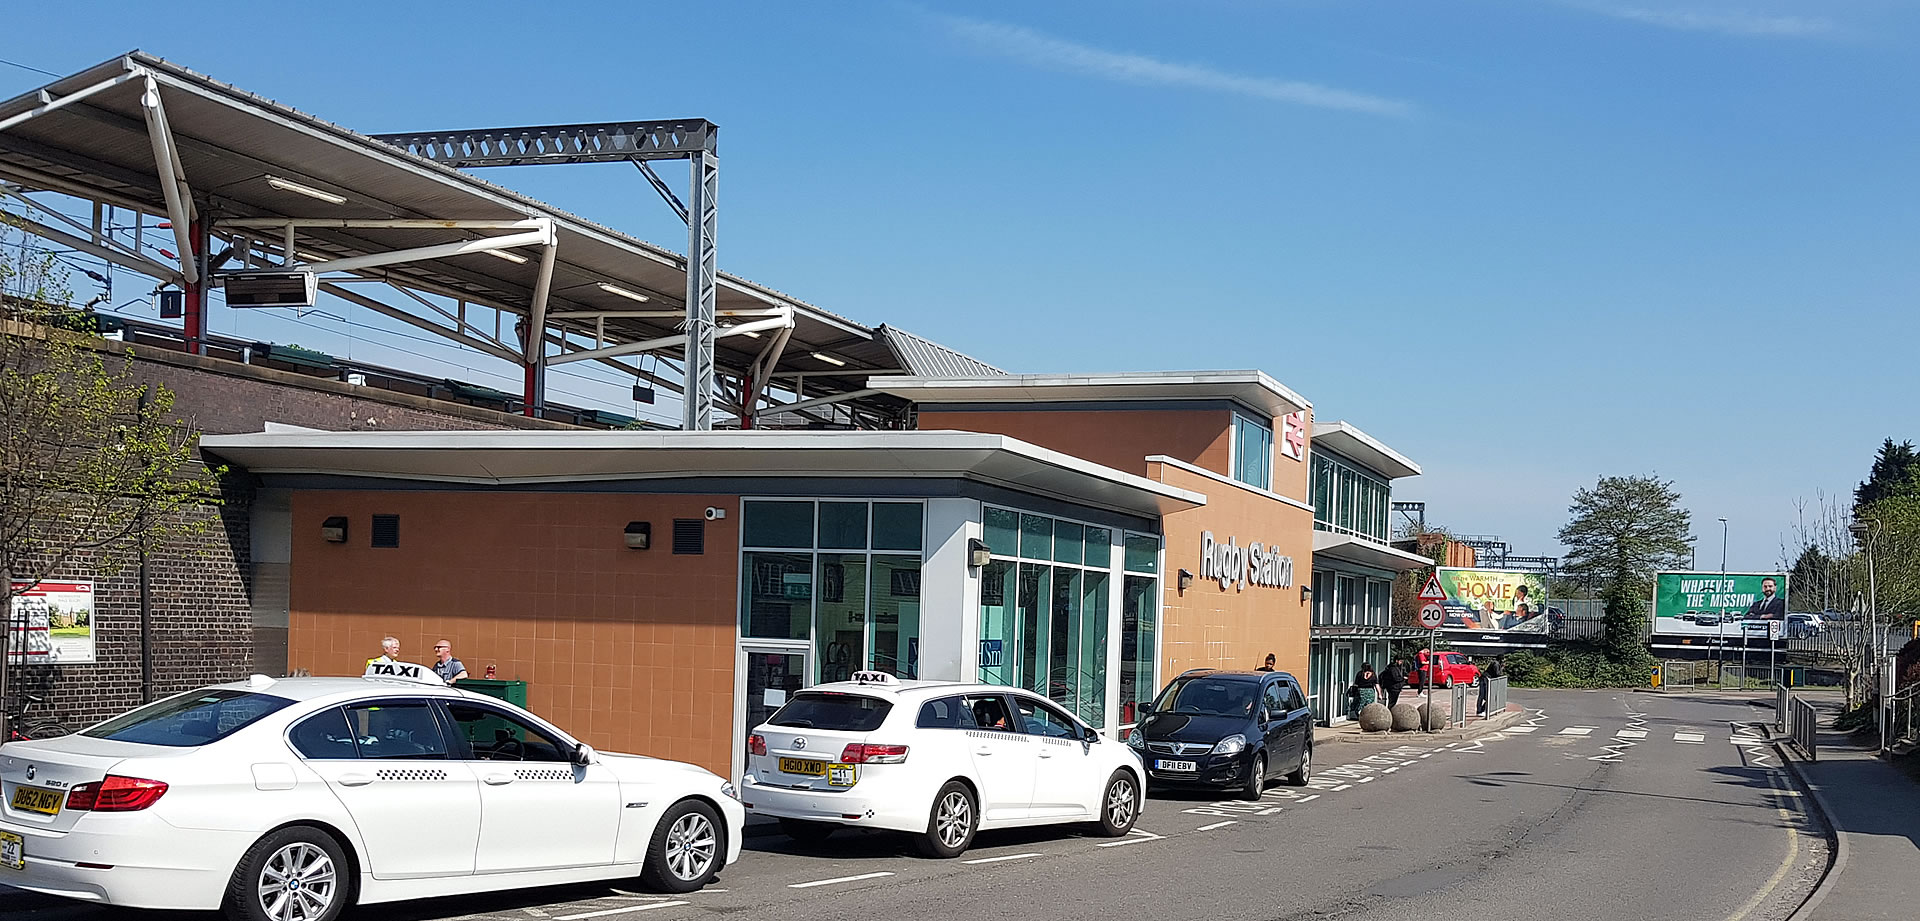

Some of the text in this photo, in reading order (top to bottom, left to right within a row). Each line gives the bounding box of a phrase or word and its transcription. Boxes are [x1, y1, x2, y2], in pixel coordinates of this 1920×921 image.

[167, 295, 172, 310] 1
[1201, 530, 1293, 590] Rugby Station
[1457, 582, 1511, 599] HOME
[1680, 579, 1735, 593] WHATEVER
[1686, 593, 1755, 608] THE MISSION
[1422, 609, 1441, 620] 20
[372, 663, 420, 678] TAXI
[853, 673, 885, 682] TAXI
[838, 769, 846, 778] 11
[45, 779, 61, 787] 520
[15, 788, 39, 807] DU62
